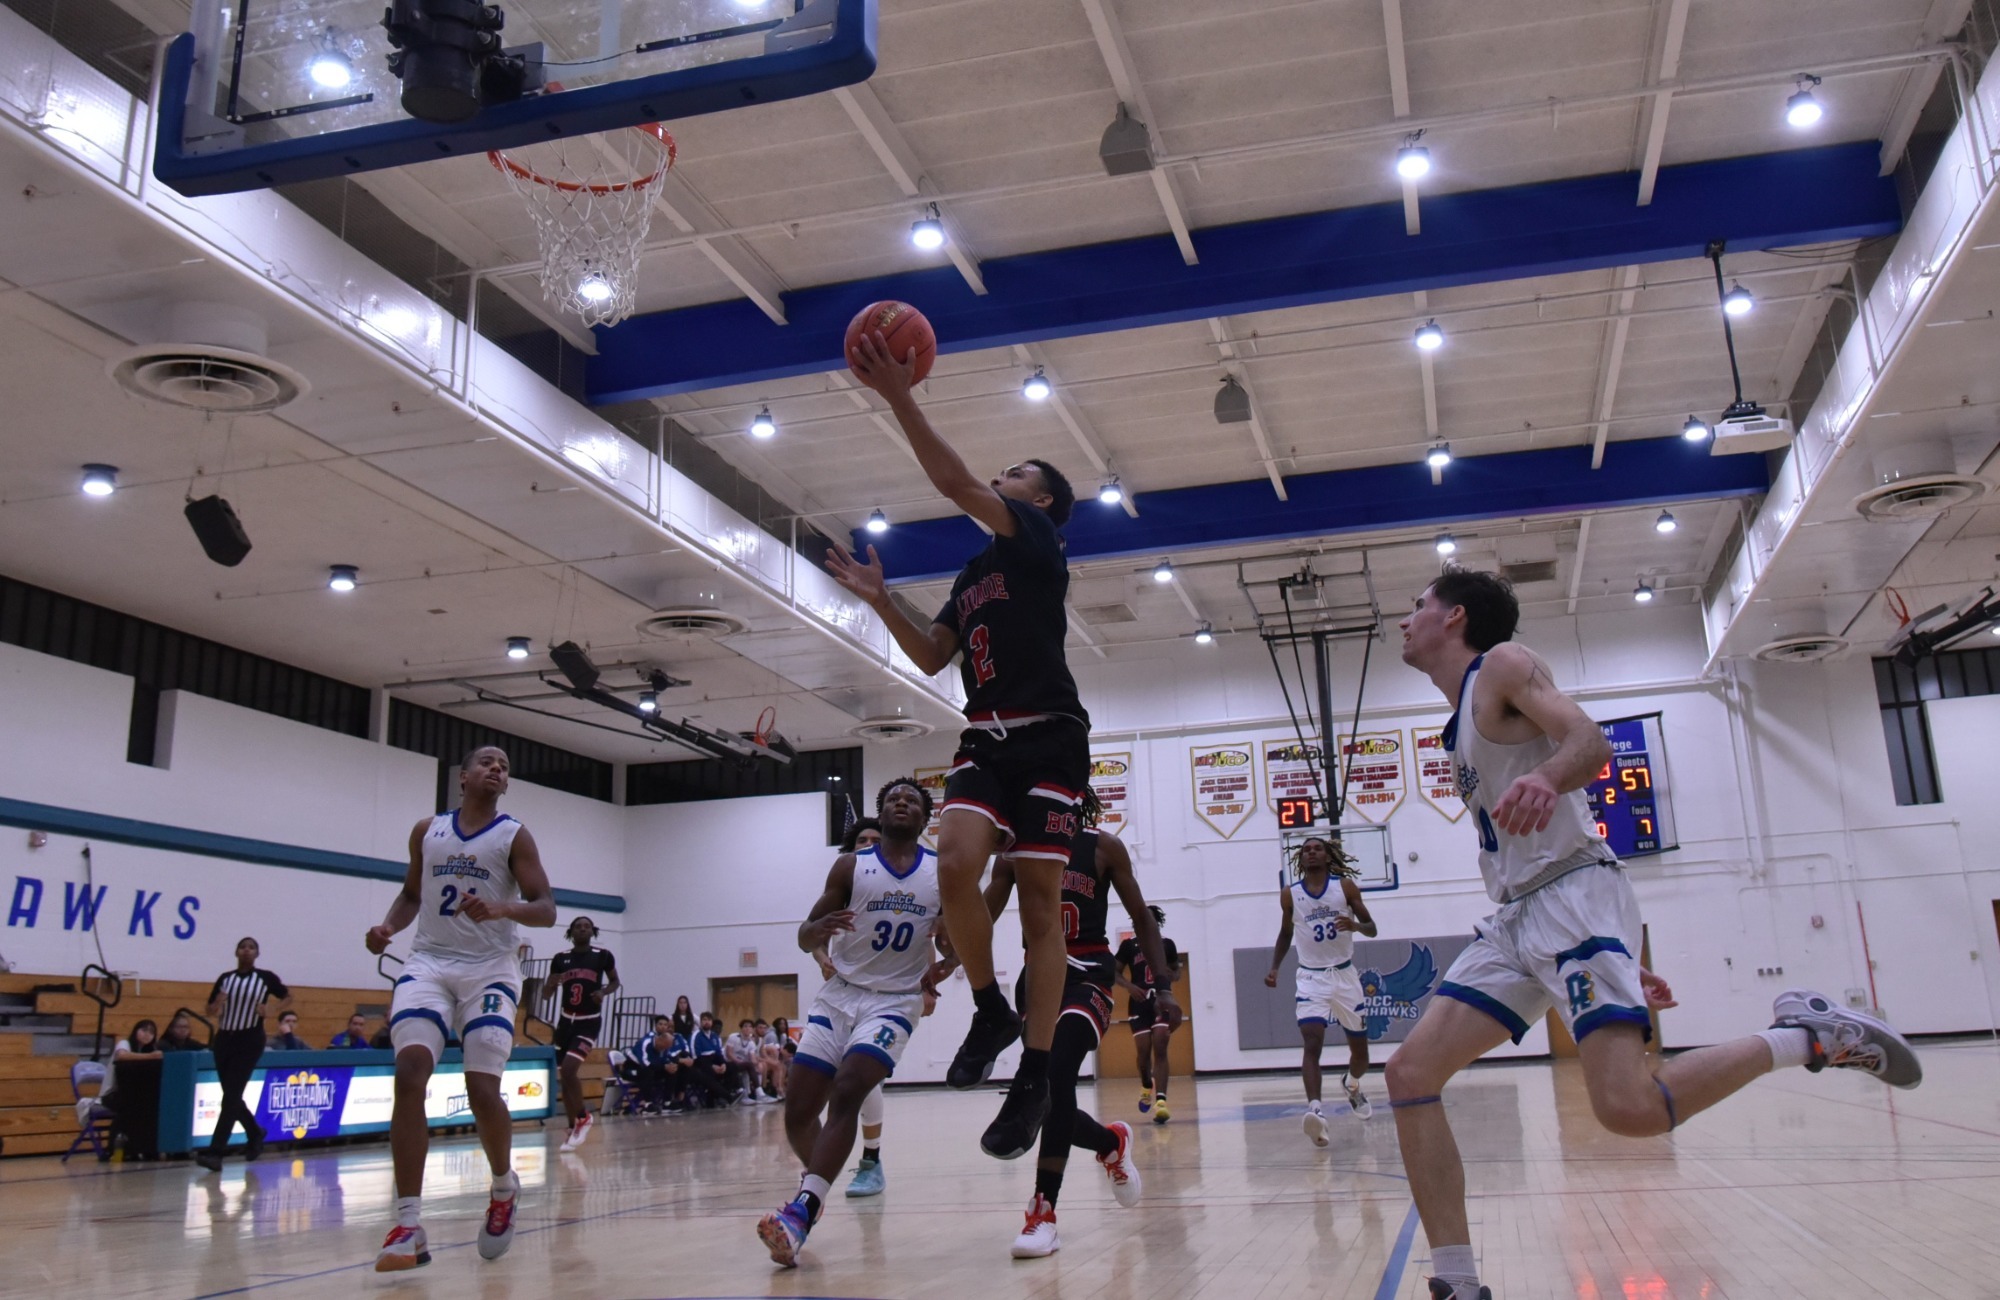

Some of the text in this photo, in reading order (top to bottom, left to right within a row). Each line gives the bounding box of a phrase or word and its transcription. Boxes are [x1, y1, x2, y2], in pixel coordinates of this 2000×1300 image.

[970, 624, 995, 688] 2
[1616, 757, 1646, 768] Guests
[1622, 768, 1650, 790] 57
[1605, 788, 1615, 804] 2
[1281, 801, 1310, 825] 27
[1641, 819, 1652, 835] 7
[1637, 841, 1654, 849] won
[433, 865, 490, 880] RIVERHAWKS
[867, 901, 926, 916] RIVERHAWKS
[884, 895, 912, 904] AACC
[871, 920, 914, 952] 30
[1313, 922, 1337, 942] 33
[570, 983, 583, 1005] 3
[272, 1085, 330, 1109] RIVERHAWK
[283, 1108, 318, 1127] NATION
